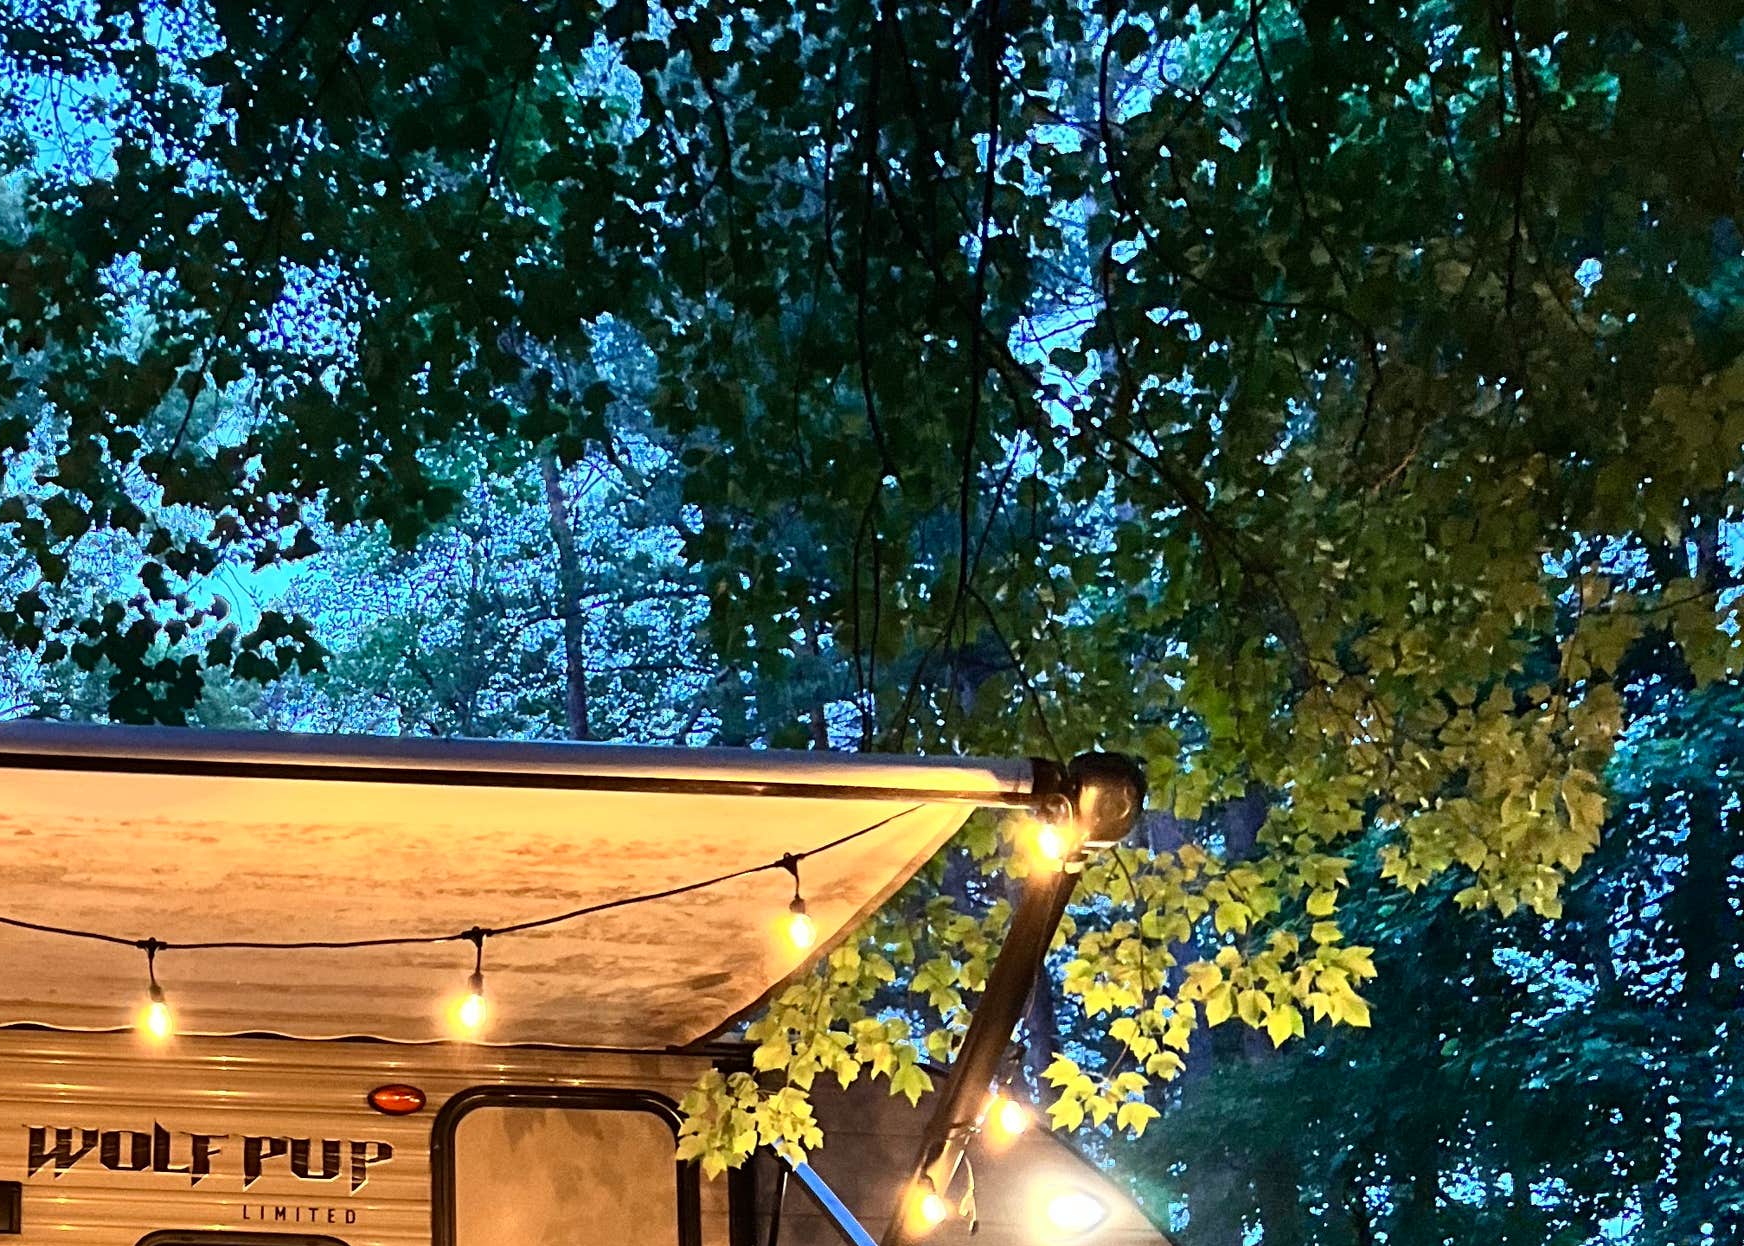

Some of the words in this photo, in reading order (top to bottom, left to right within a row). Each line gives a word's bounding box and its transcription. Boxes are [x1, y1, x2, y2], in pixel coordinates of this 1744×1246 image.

[22, 1120, 229, 1187] WOLF
[242, 1135, 394, 1196] PUP
[242, 1204, 356, 1224] LIMITED
